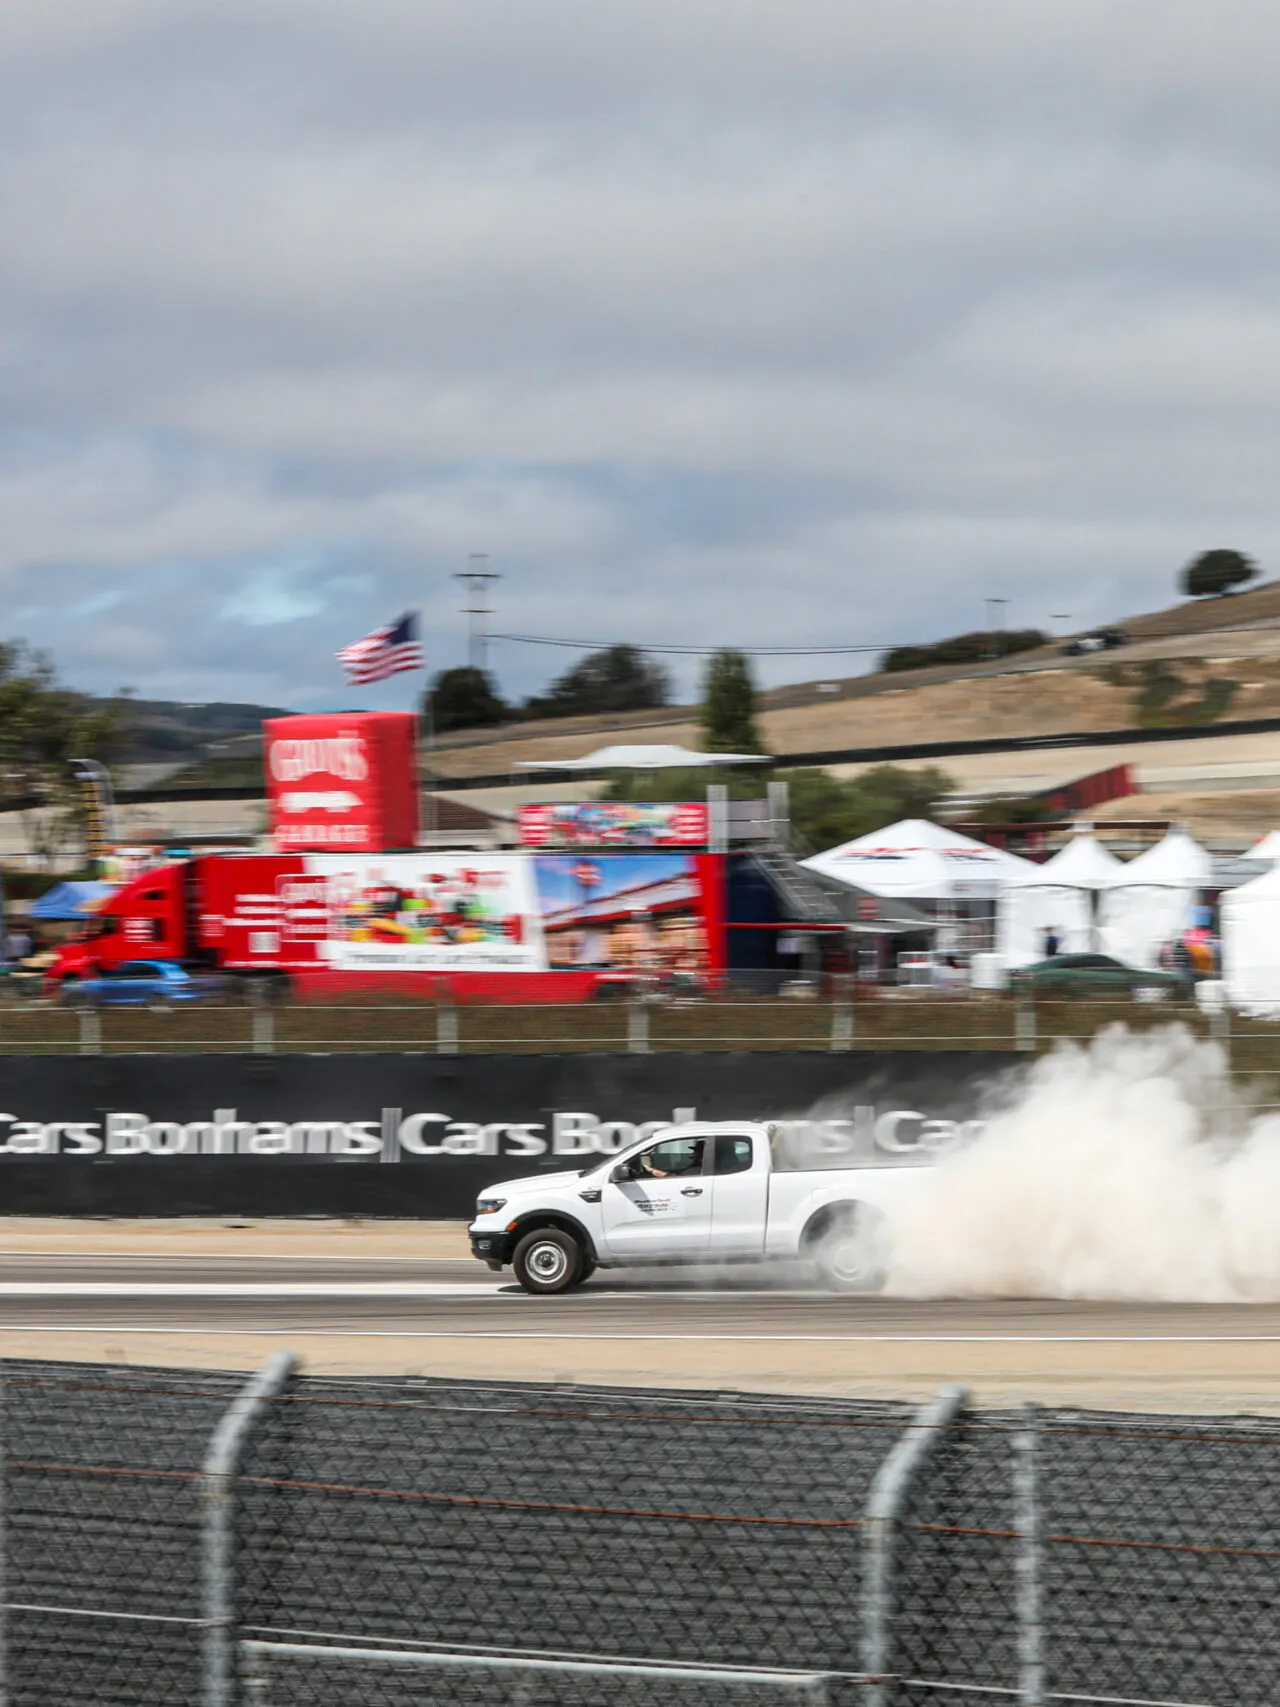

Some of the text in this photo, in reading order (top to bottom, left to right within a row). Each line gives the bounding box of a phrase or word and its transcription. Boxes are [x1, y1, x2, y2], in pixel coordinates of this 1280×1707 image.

[105, 1107, 383, 1155] Bonhams
[398, 1112, 548, 1156] Cars
[874, 1110, 990, 1153] Car
